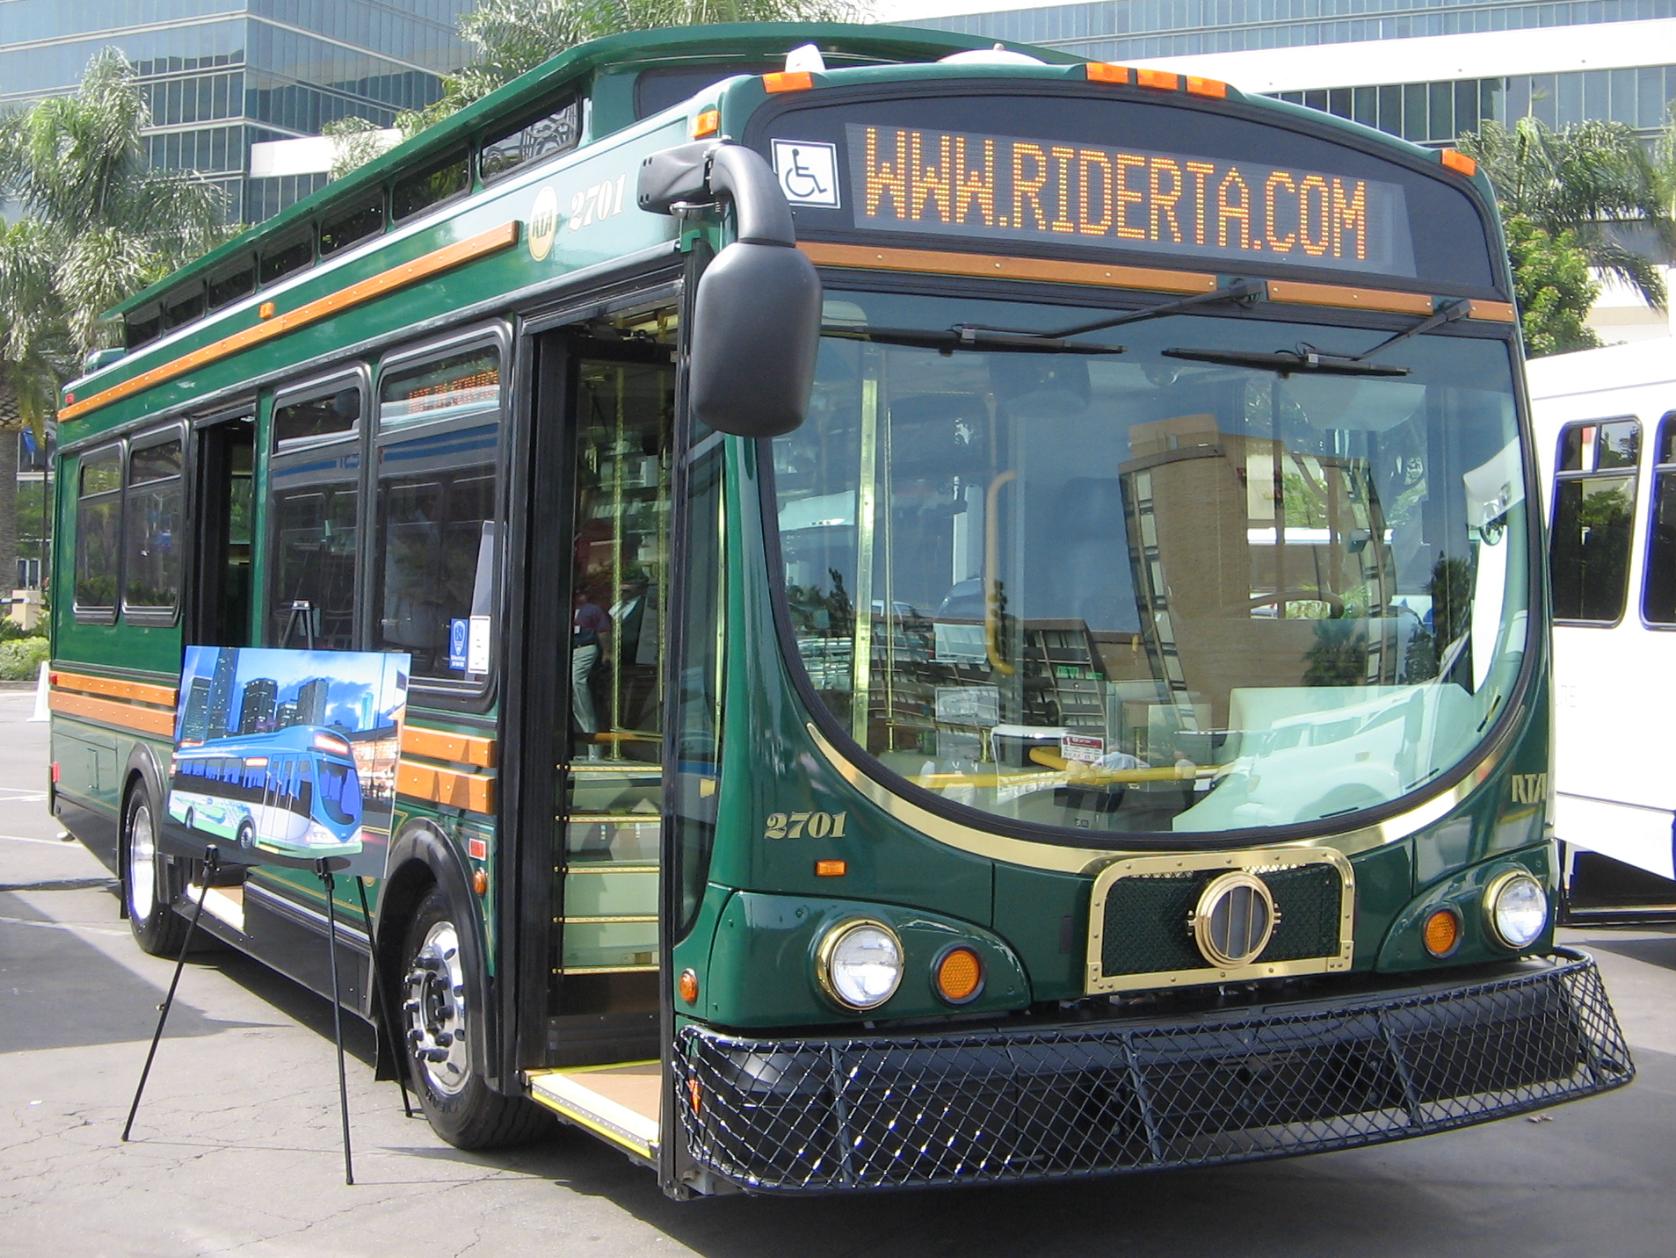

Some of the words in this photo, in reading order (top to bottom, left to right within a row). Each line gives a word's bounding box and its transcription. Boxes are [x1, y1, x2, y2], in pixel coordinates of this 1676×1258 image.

[568, 174, 626, 231] 2701
[865, 126, 1369, 260] WWW.RIDERTA.COM
[1511, 772, 1547, 804] RTA
[764, 811, 847, 839] 2701
